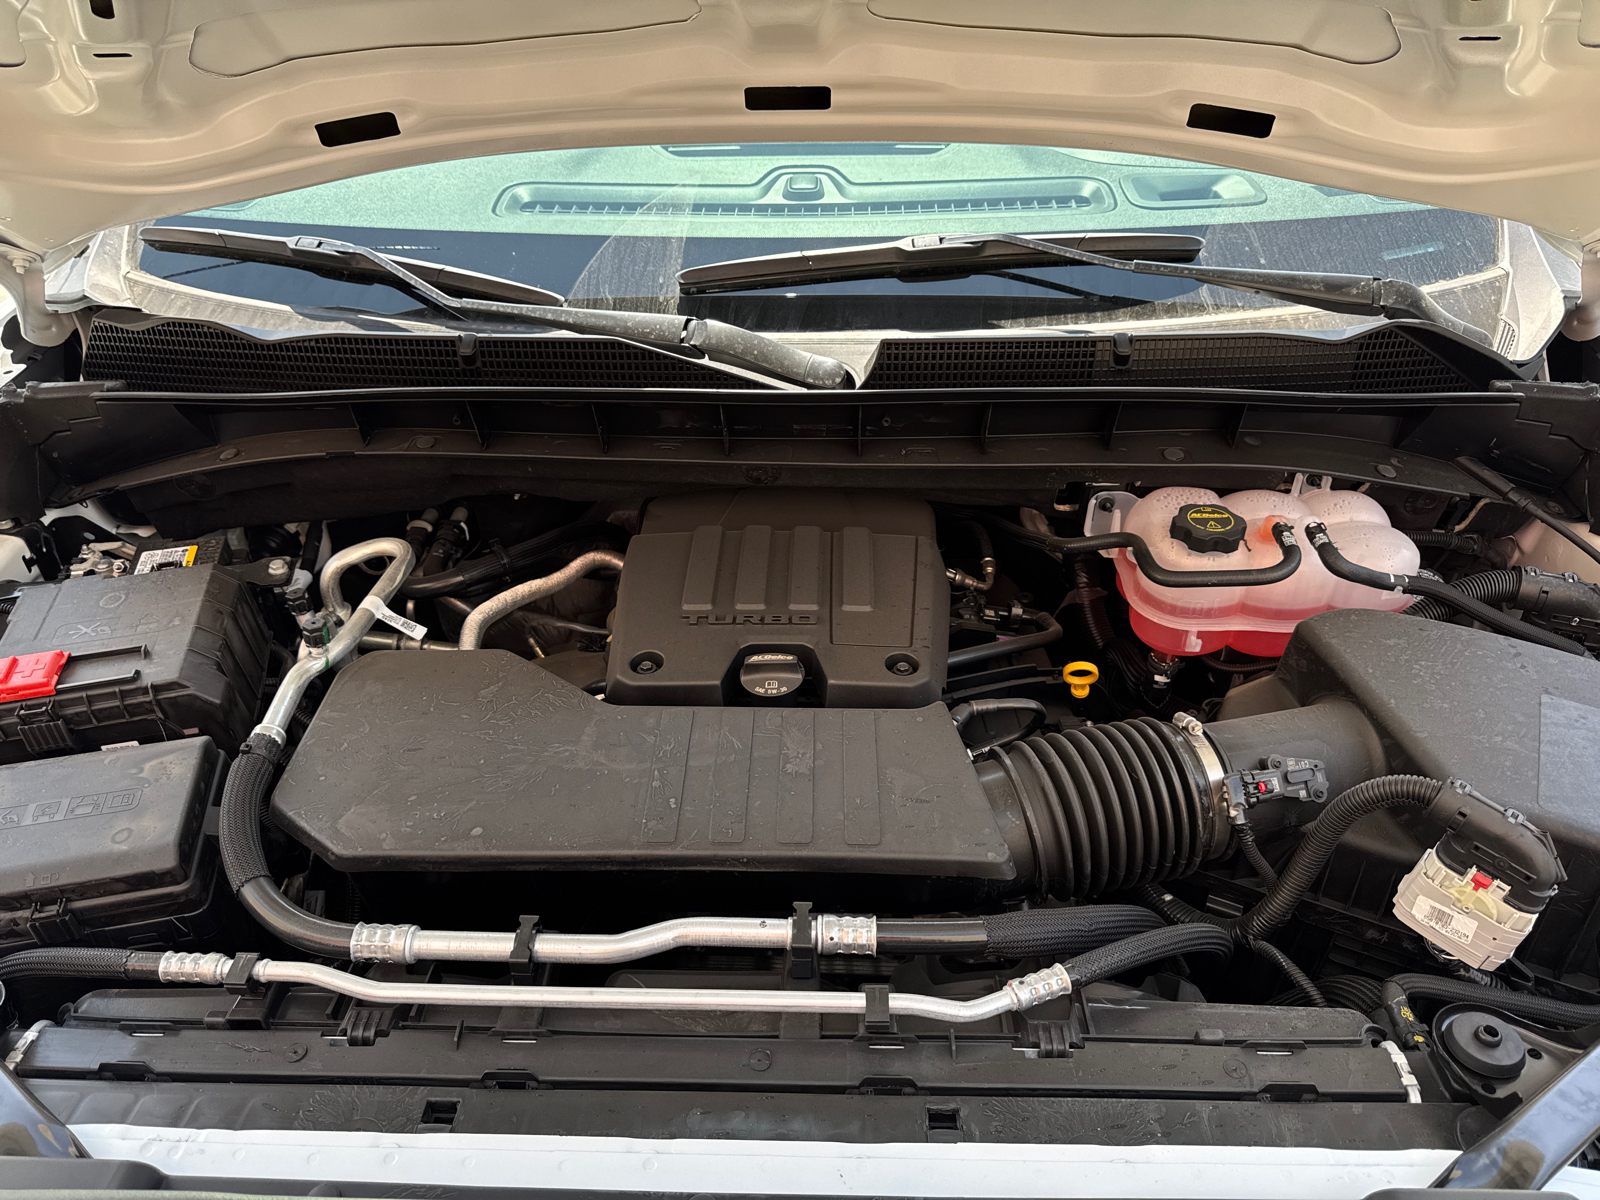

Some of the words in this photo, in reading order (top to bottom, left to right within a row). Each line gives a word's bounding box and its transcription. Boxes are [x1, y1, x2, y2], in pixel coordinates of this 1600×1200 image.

[681, 614, 819, 626] TURBO
[748, 654, 794, 662] ACDelco
[754, 686, 766, 694] SAE
[767, 686, 788, 695] 5W-30
